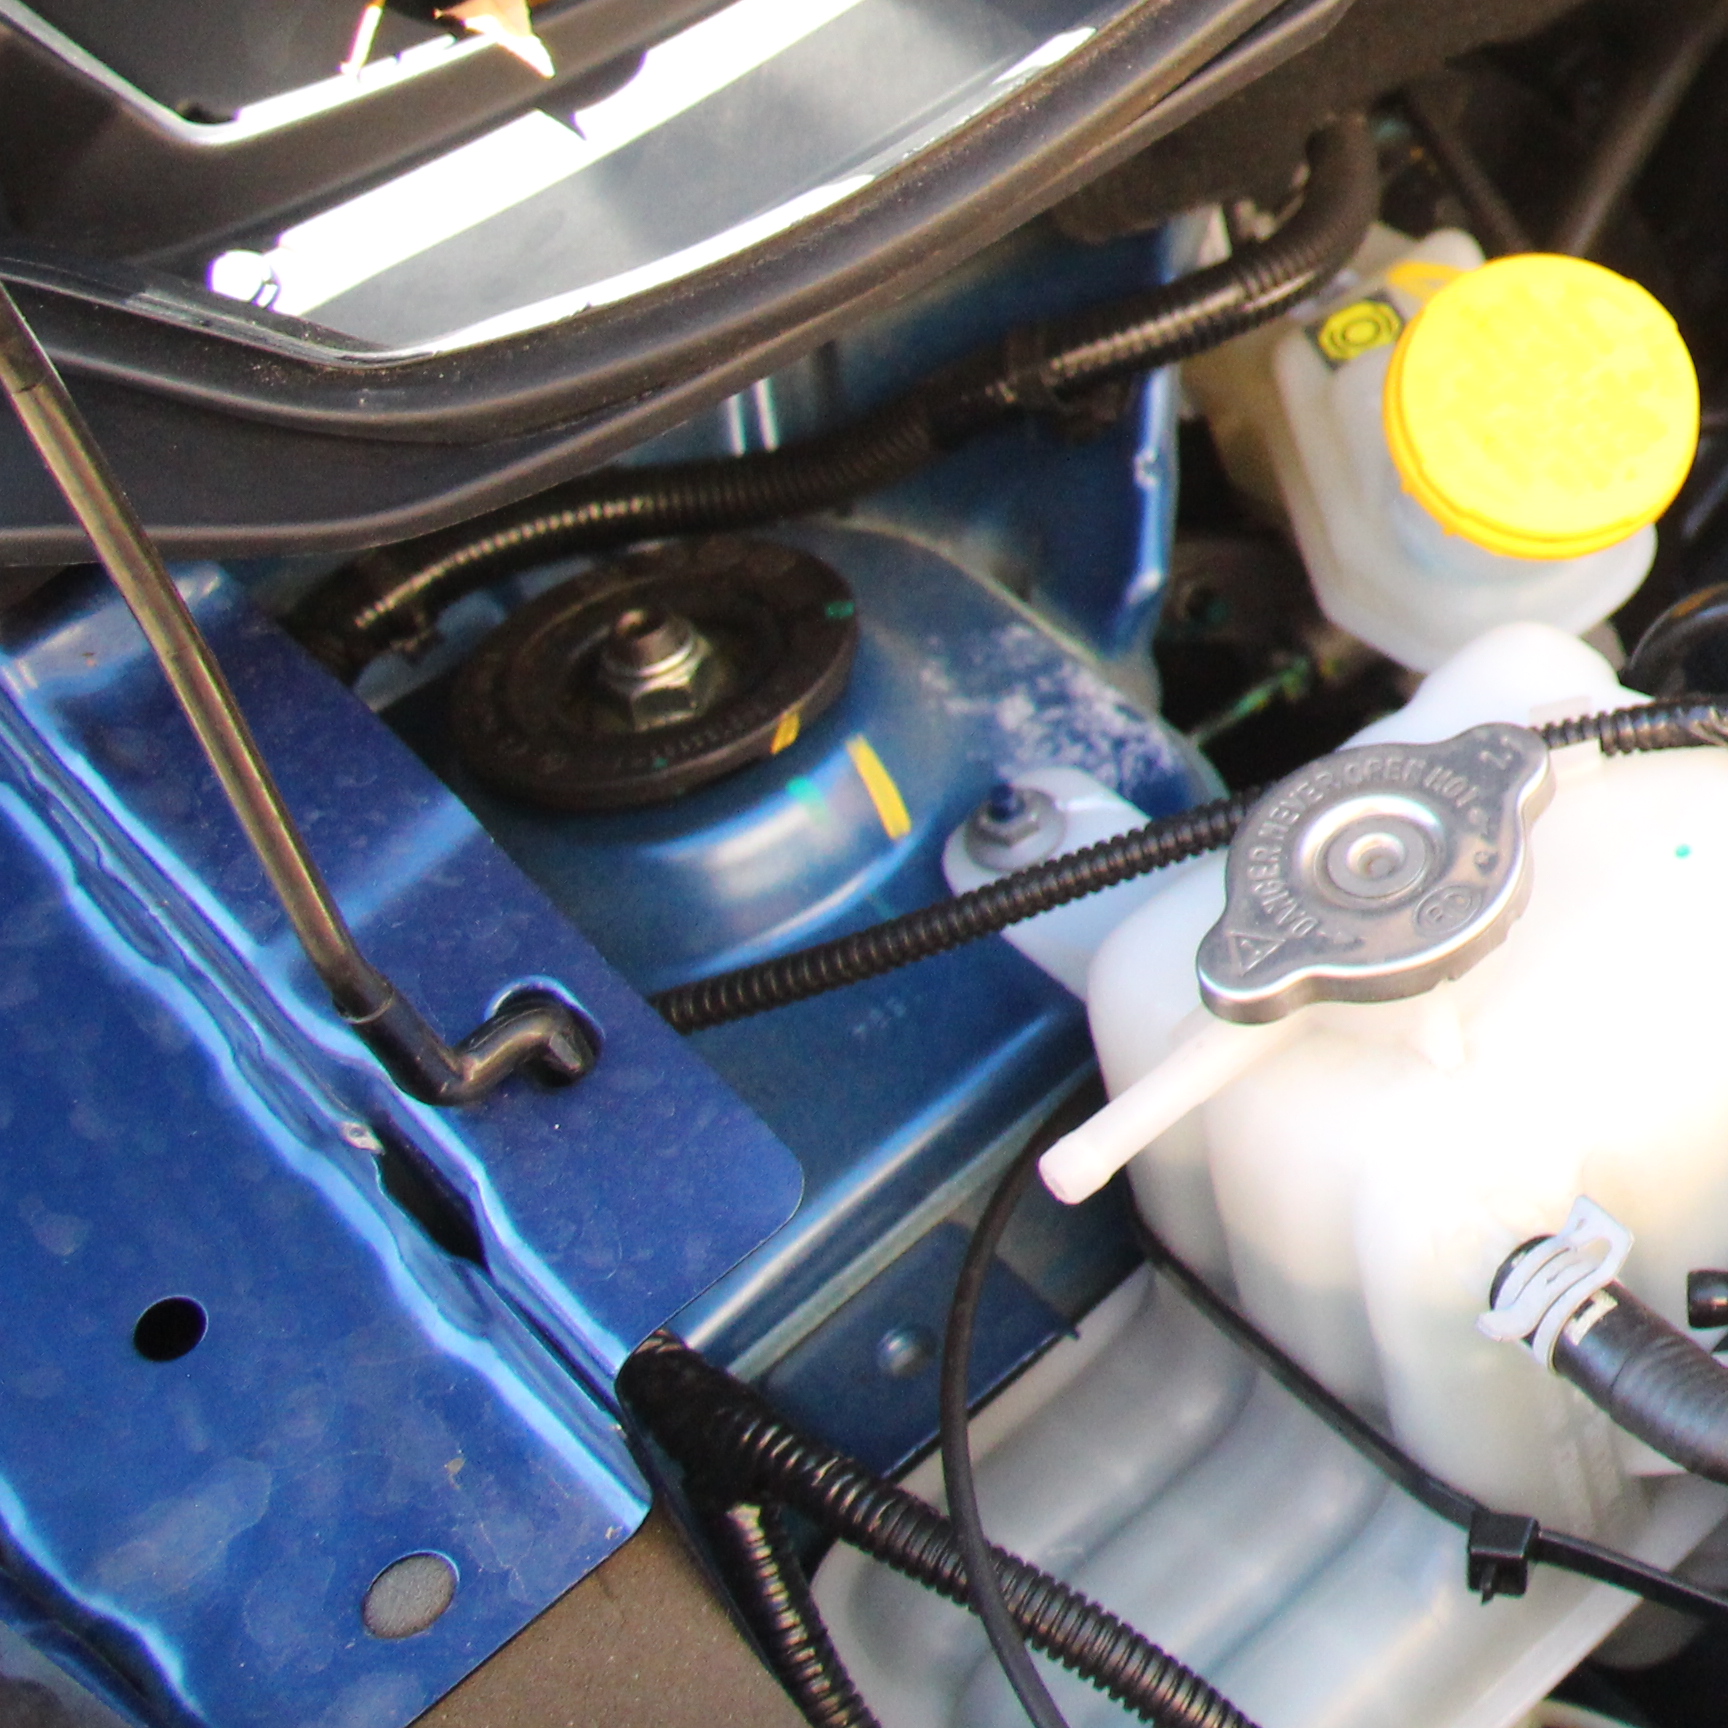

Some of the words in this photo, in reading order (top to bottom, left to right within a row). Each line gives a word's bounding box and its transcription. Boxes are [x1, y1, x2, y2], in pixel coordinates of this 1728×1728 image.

[1343, 755, 1427, 783] OPEN
[1423, 765, 1479, 809] HOT
[1257, 770, 1341, 839] NEVER
[1248, 847, 1319, 939] DANGER
